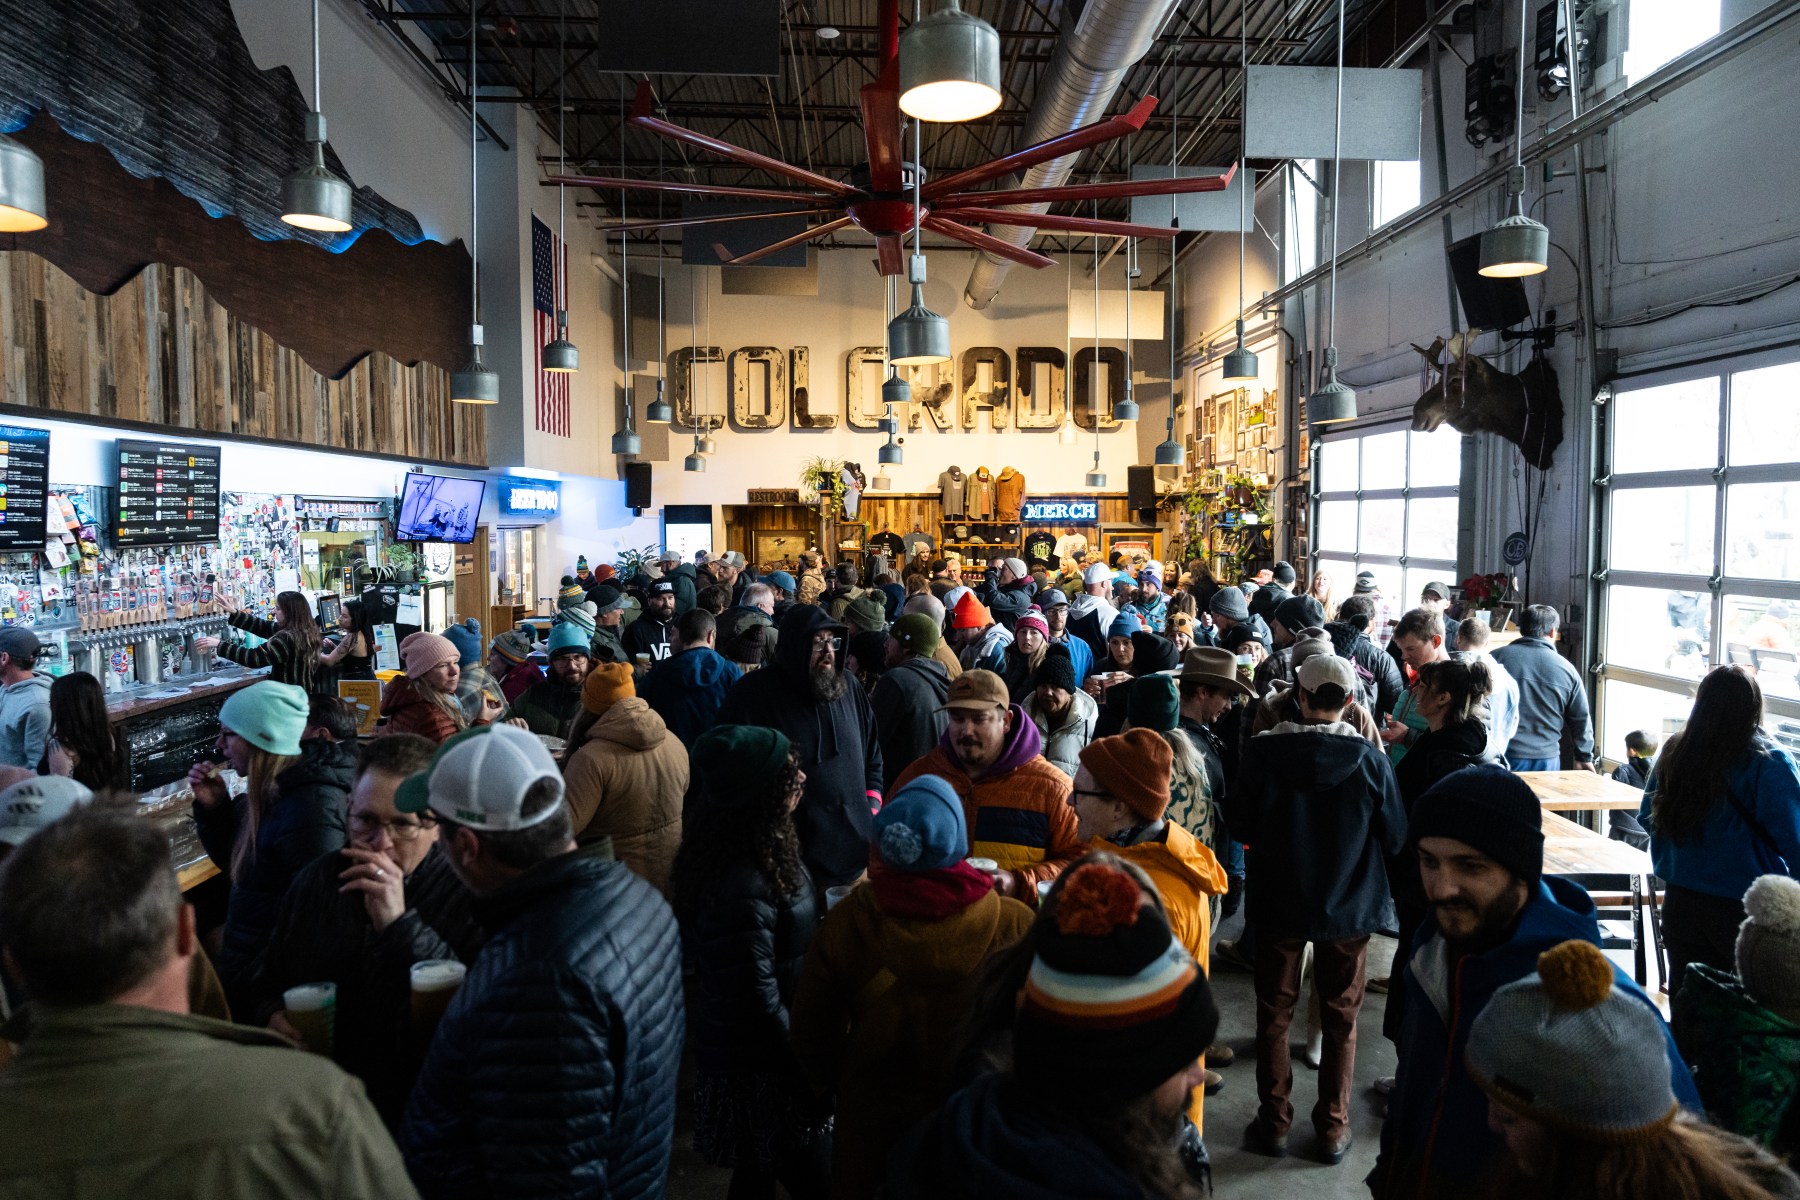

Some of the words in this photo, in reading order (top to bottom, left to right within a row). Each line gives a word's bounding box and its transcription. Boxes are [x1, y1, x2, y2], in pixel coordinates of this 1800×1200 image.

[676, 346, 1128, 429] COLORADO
[511, 489, 535, 509] BEER
[535, 490, 547, 510] TO
[547, 491, 558, 510] GO
[748, 491, 798, 503] RESTROOMS
[1025, 503, 1097, 519] MERCH
